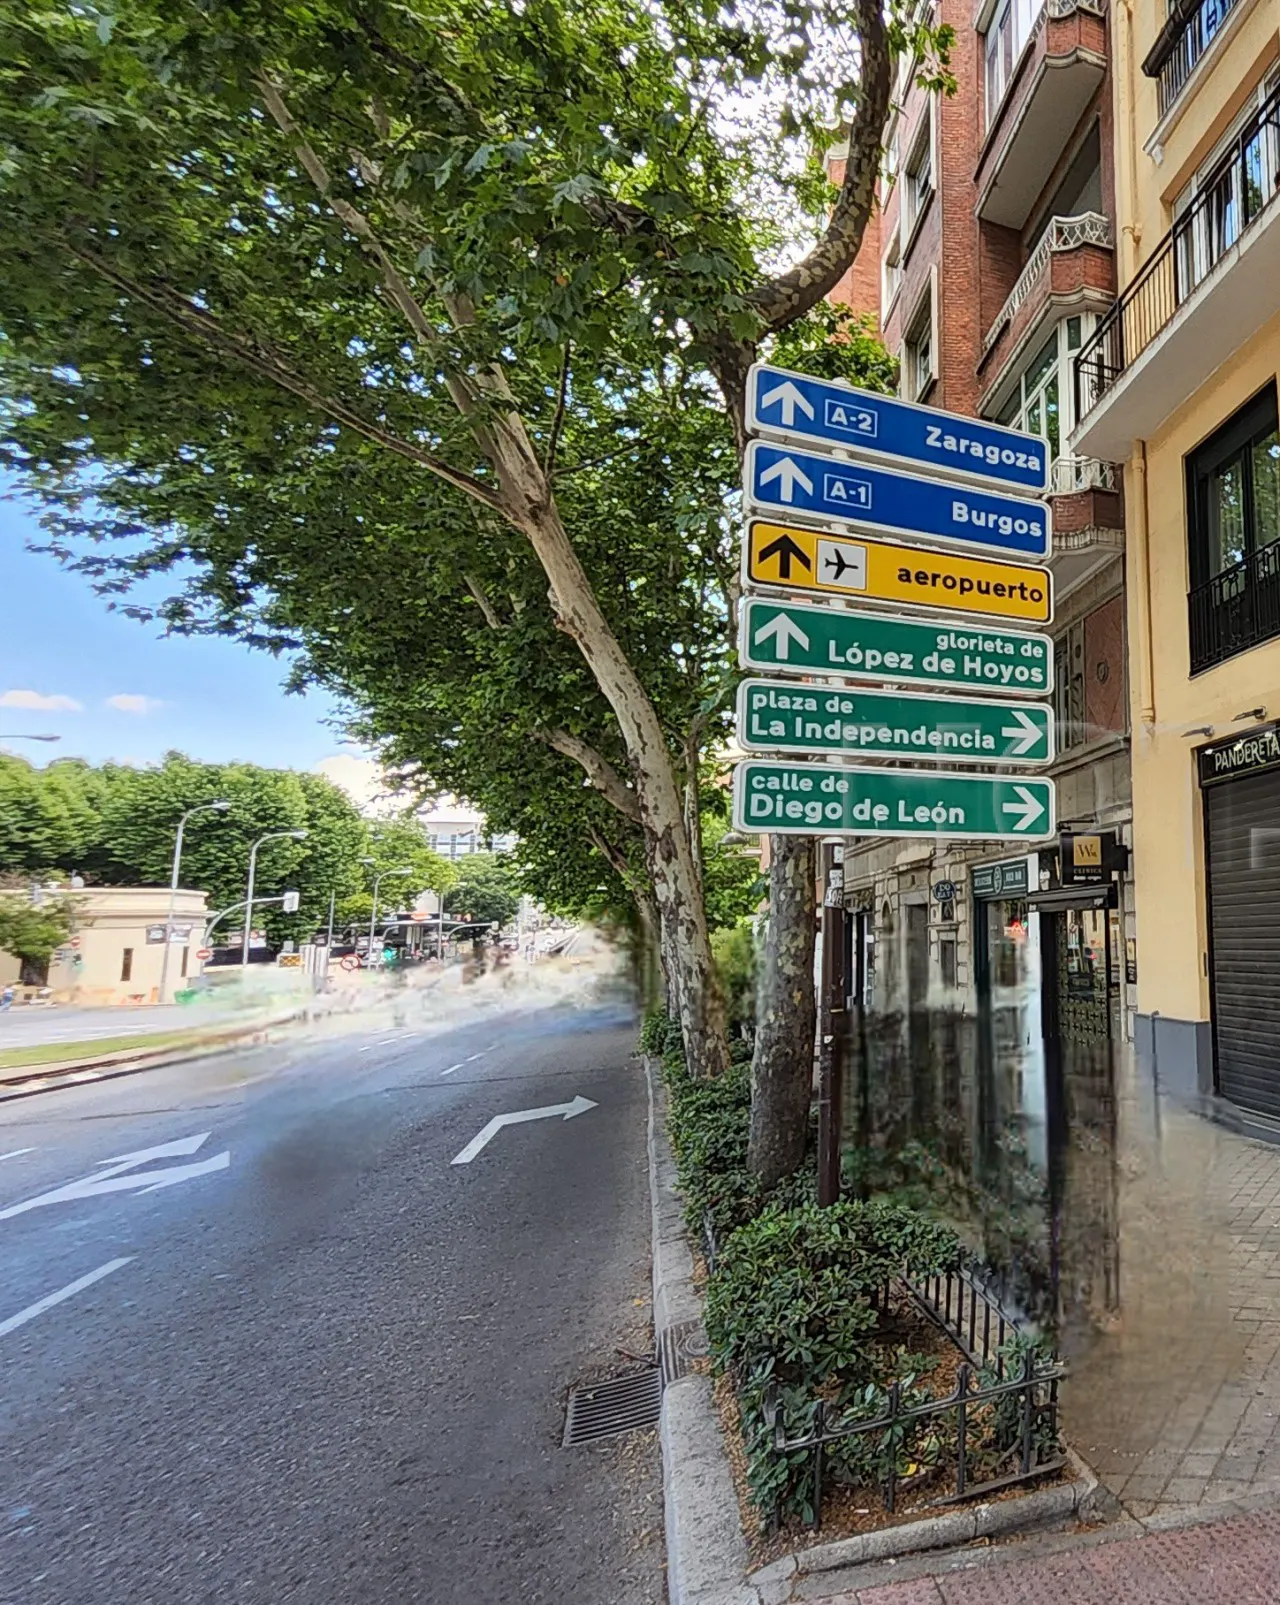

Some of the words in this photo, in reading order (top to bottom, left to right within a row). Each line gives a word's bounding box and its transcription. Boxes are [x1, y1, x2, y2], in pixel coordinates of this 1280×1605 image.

[830, 407, 873, 431] A-2
[925, 425, 1041, 472] Zaragoza
[829, 481, 868, 503] A-1
[952, 501, 1043, 537] Burgos
[897, 567, 1043, 603] aeropuerto
[828, 640, 914, 670] López
[922, 652, 956, 673] de
[963, 655, 1043, 684] Hoyos
[936, 631, 1015, 655] glorieta
[1020, 641, 1043, 658] de
[752, 690, 817, 712] plaza
[824, 695, 854, 714] de
[751, 714, 786, 737] La
[795, 717, 996, 751] Independencia
[1214, 733, 1280, 772] PANDERETA
[751, 772, 814, 792] calle
[820, 775, 849, 794] de
[749, 793, 844, 824] Diego
[852, 798, 890, 823] de
[897, 799, 965, 824] León
